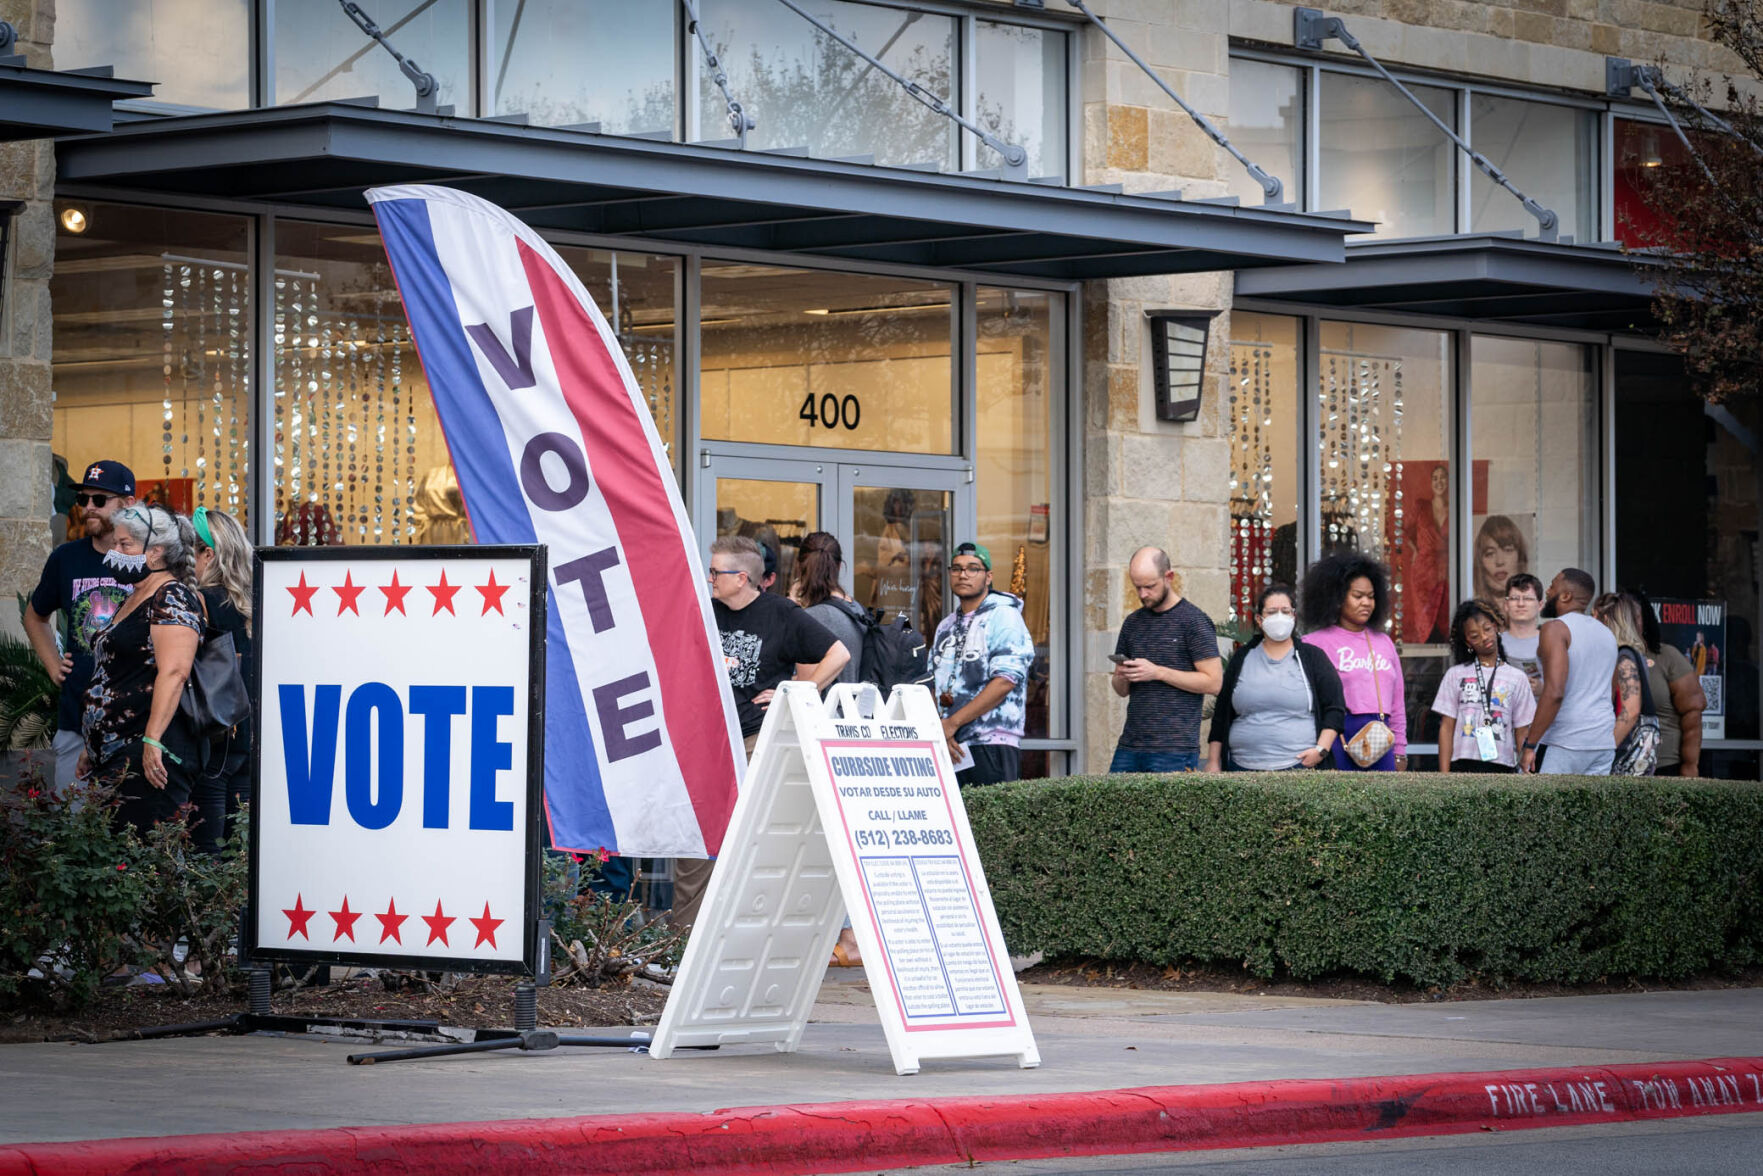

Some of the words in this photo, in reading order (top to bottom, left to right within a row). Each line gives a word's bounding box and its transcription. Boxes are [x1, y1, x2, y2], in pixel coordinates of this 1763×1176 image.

[799, 392, 861, 430] 400
[465, 305, 663, 764] VOTE
[1663, 603, 1696, 624] ENROLL
[1697, 604, 1721, 626] NOW
[1337, 646, 1392, 672] Barbie
[835, 725, 860, 738] TRAVIS
[860, 725, 872, 739] CO
[880, 725, 918, 740] ELECTIONS
[278, 682, 514, 831] VOTE
[831, 756, 892, 777] CURBSIDE
[890, 757, 936, 777] VOTING
[839, 787, 872, 797] VOTAR
[873, 787, 902, 797] DESDE
[902, 787, 914, 797] SU
[916, 787, 941, 797] AUTO
[868, 810, 891, 820] CALL
[897, 810, 928, 820] LLAME
[855, 829, 890, 850] (512)
[891, 829, 953, 845] 238-8683
[1485, 1083, 1546, 1116] FIRE
[1548, 1081, 1616, 1113] LANE
[1633, 1078, 1683, 1111] TOW
[1687, 1074, 1744, 1109] AWAY
